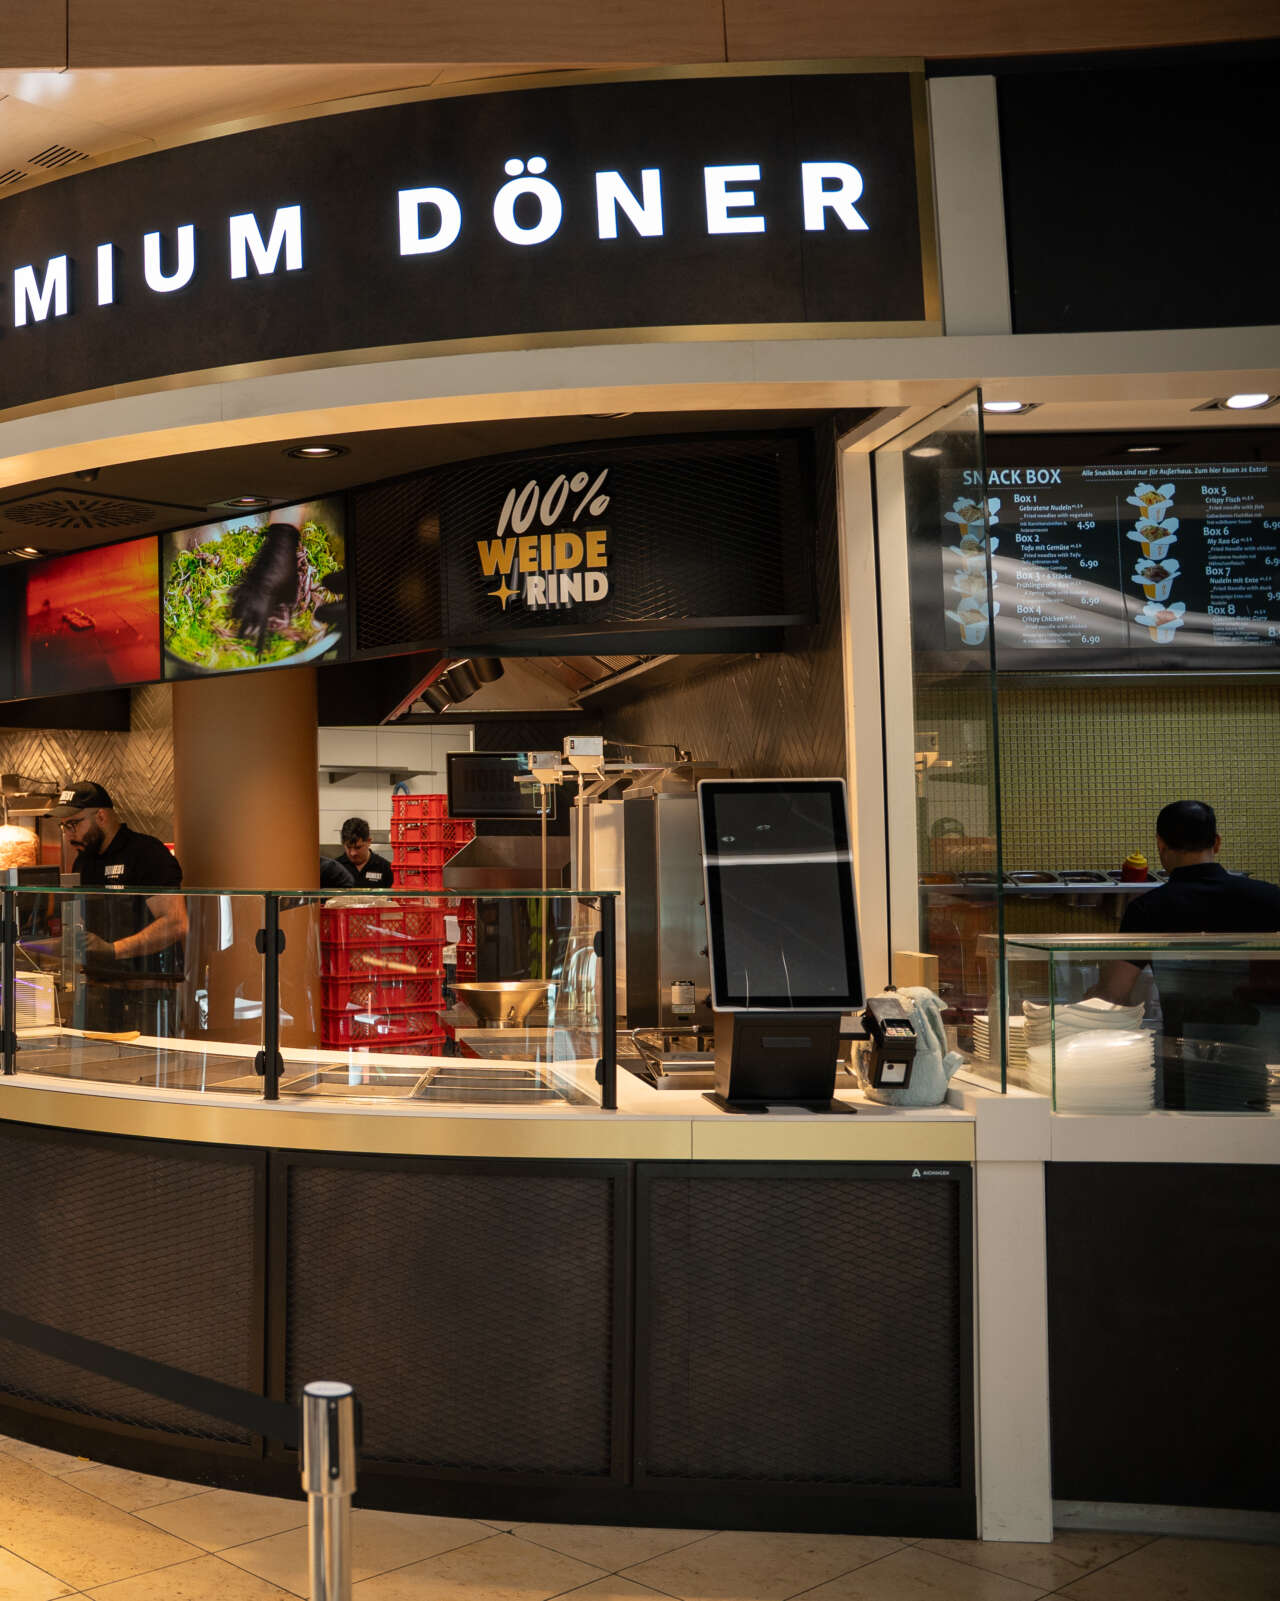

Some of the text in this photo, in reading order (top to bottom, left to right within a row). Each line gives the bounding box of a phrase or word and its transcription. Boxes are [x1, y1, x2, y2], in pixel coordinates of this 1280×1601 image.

[397, 156, 870, 256] DÖNER
[962, 468, 1062, 486] SNACK BOX
[1201, 485, 1227, 496] Box 5
[496, 468, 611, 538] 100%
[1014, 493, 1037, 503] Box 1
[1077, 521, 1096, 530] 4.50
[1203, 526, 1229, 536] Box 6
[1016, 533, 1040, 543] Box 2
[477, 530, 608, 576] WEIDE
[1080, 559, 1099, 569] 6.90
[1265, 556, 1280, 566] 6.9
[1016, 570, 1033, 580] Box
[1205, 566, 1231, 577] Box 7
[527, 571, 609, 606] RIND
[1081, 596, 1100, 606] 6.90
[1267, 592, 1280, 601] 9.9
[1016, 604, 1041, 615] Box 4
[1207, 604, 1236, 615] Box 8
[1081, 635, 1101, 645] 6.90
